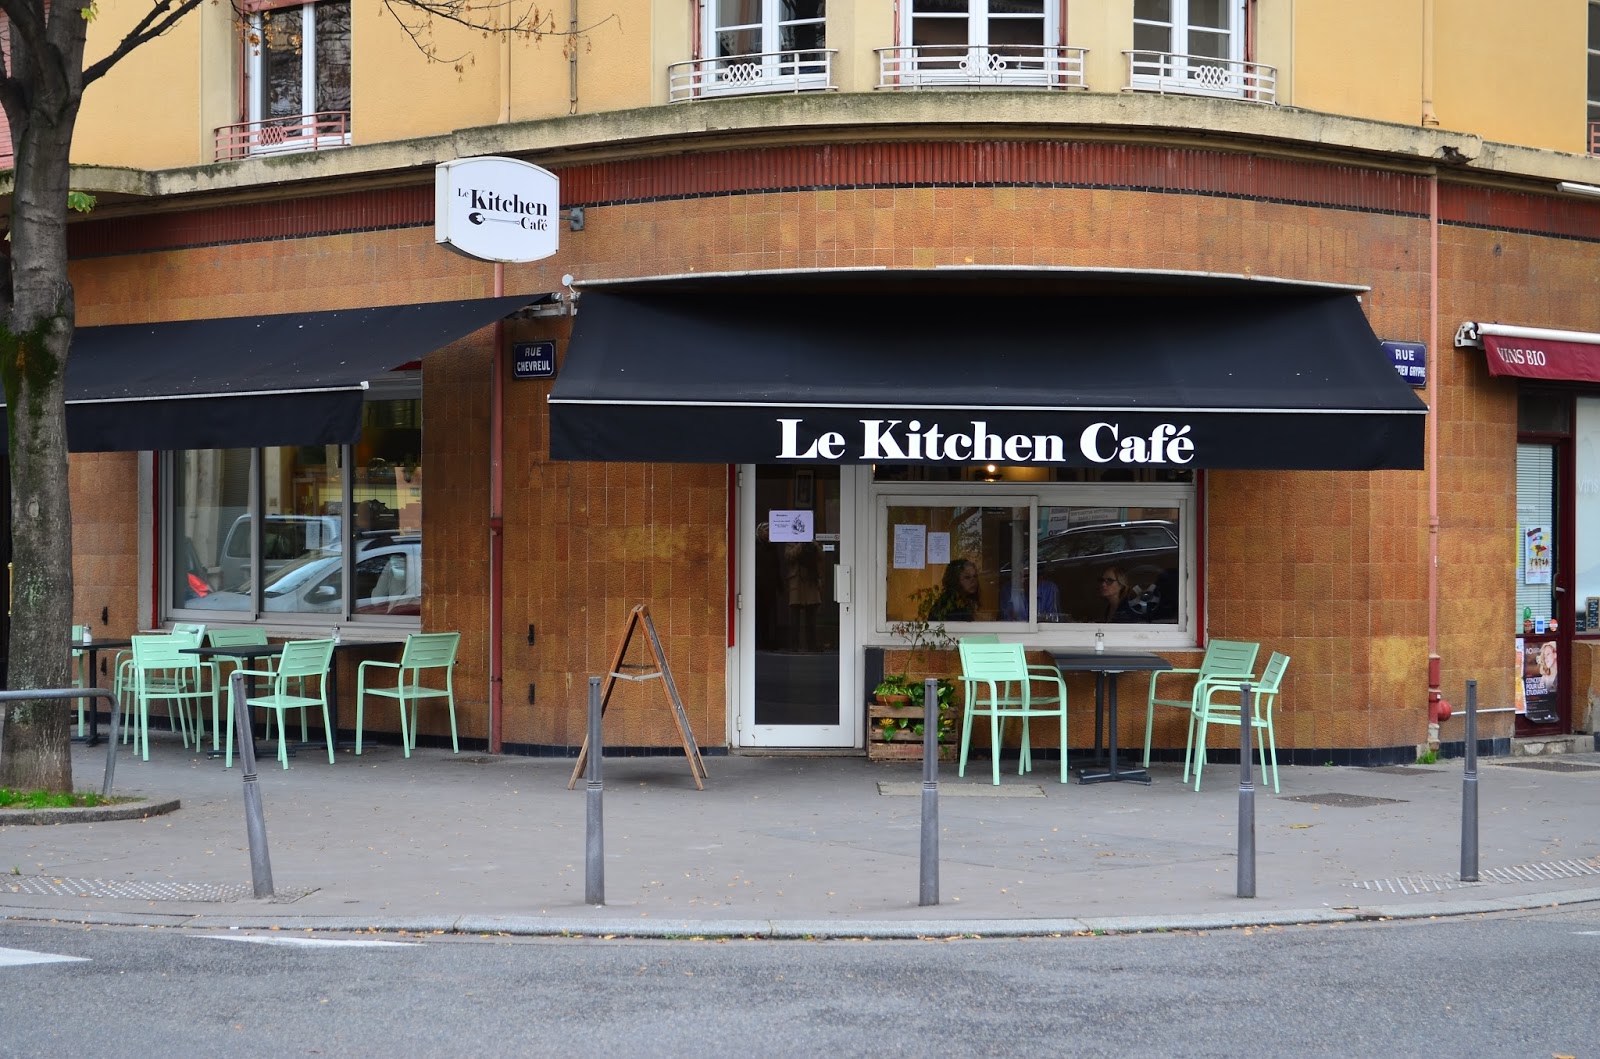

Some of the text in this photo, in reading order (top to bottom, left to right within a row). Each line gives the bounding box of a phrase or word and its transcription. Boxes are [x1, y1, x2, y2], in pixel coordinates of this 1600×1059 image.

[457, 187, 548, 216] Le Kitchen
[520, 216, 548, 231] Café
[524, 347, 542, 357] RUE
[1395, 348, 1415, 361] RUE
[1496, 347, 1546, 366] VINS BIO
[516, 360, 551, 372] CHEVREUL
[776, 418, 1195, 464] Le Kitchen Café
